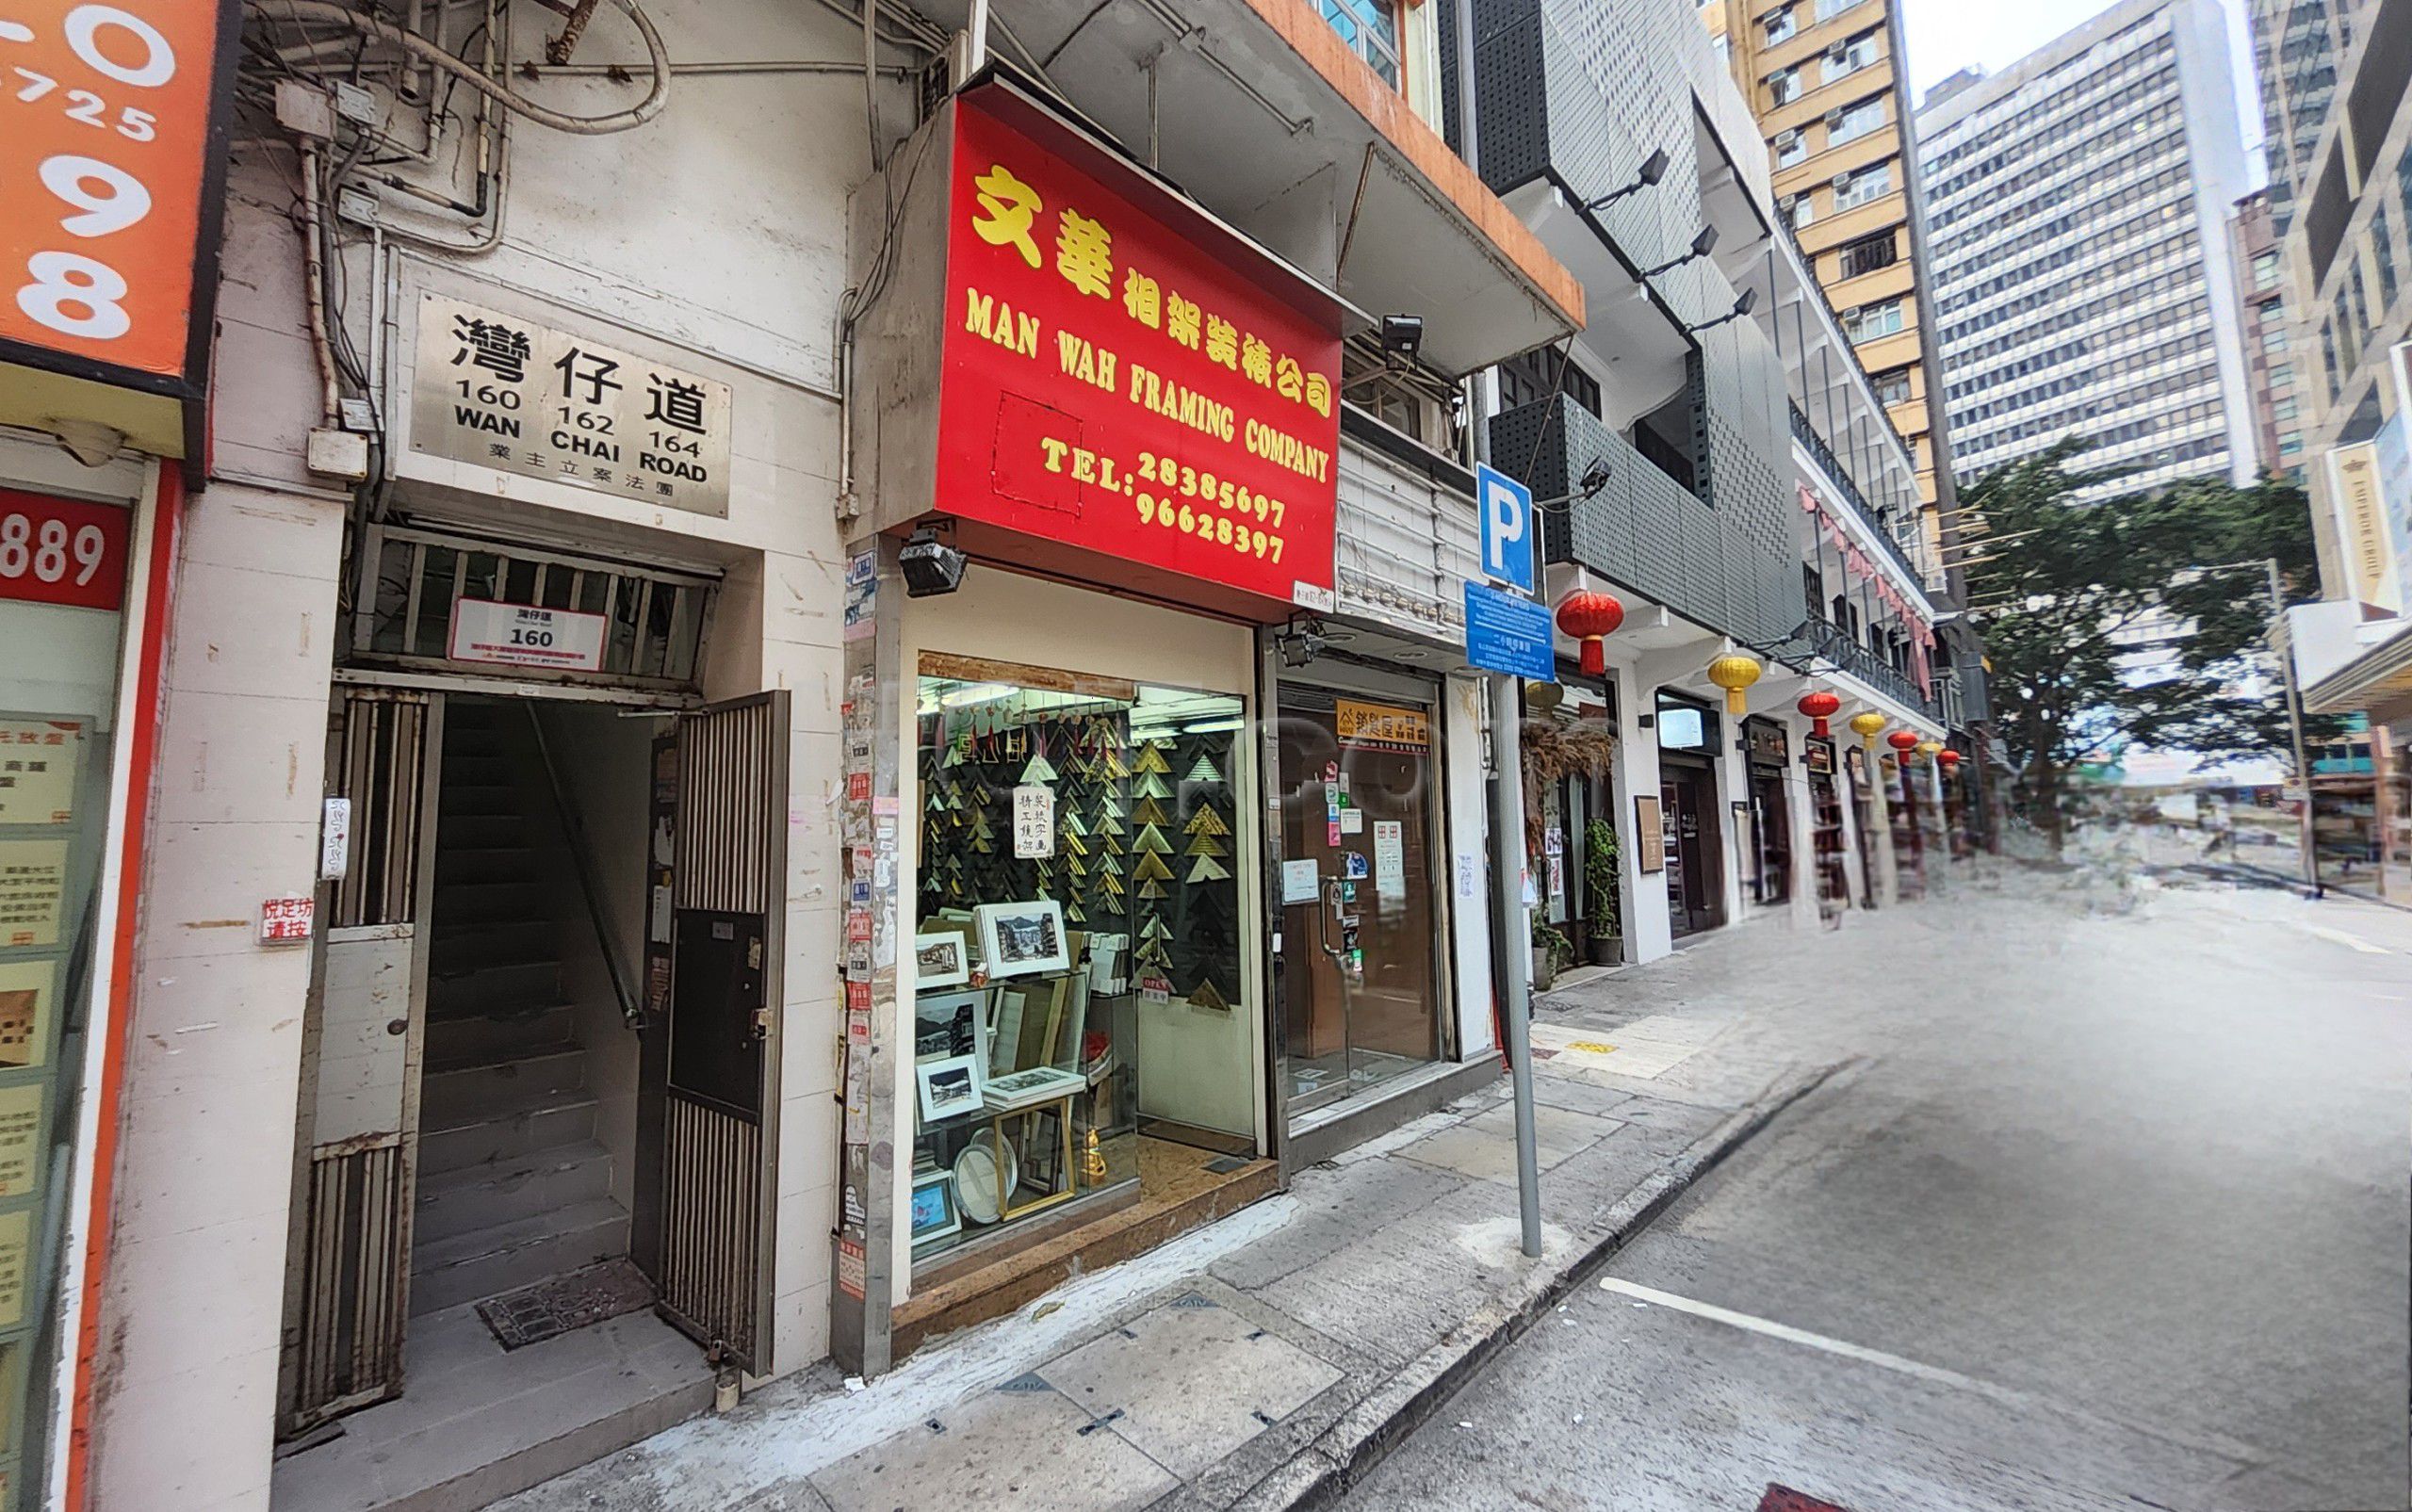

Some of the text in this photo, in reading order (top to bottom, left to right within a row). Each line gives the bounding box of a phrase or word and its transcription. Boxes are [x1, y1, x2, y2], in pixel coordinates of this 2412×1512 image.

[450, 314, 707, 435] 灣仔道
[966, 287, 1330, 483] MAN WAH FRAMING COMPANY
[454, 405, 708, 483] WAN CHAI ROAD
[455, 379, 703, 459] 160 162 164
[489, 443, 674, 497] 業主立案法團
[1137, 452, 1285, 528] 28385697
[0, 513, 105, 586] 889
[1136, 495, 1284, 565] 96628397
[1488, 480, 1524, 570] P
[2353, 480, 2382, 578] EMPEROR GROUP
[510, 628, 554, 647] 160
[517, 609, 552, 622] 灣仔道
